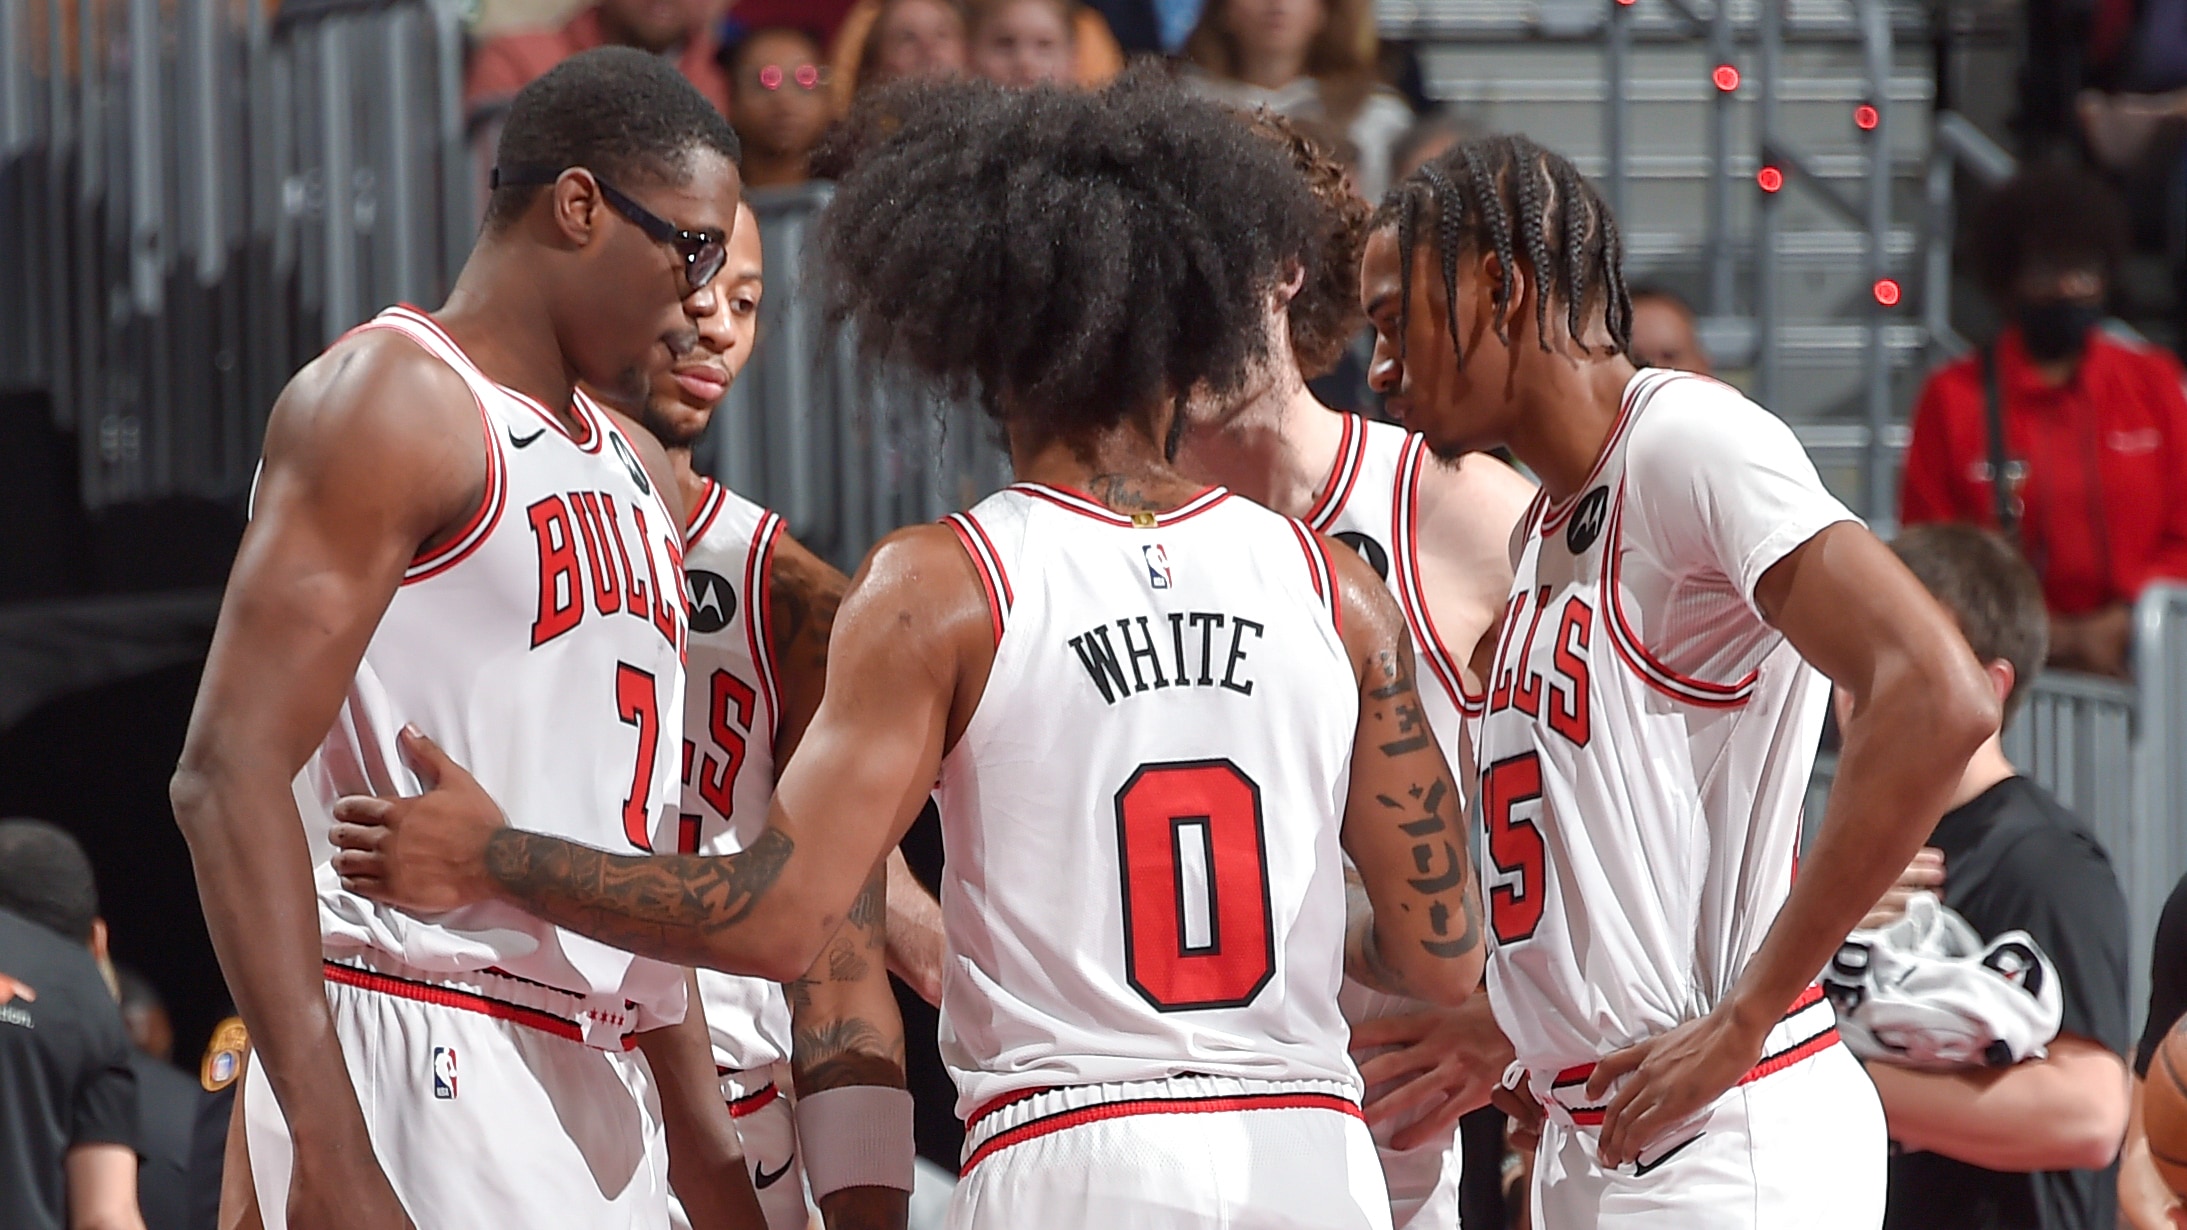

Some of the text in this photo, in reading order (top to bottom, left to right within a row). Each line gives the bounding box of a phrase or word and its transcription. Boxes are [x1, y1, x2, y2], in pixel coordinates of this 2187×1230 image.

[1067, 612, 1264, 704] WHITE
[1490, 585, 1592, 748] LLS
[616, 660, 660, 854] 7
[1482, 749, 1546, 947] 5
[1114, 758, 1276, 1013] 0
